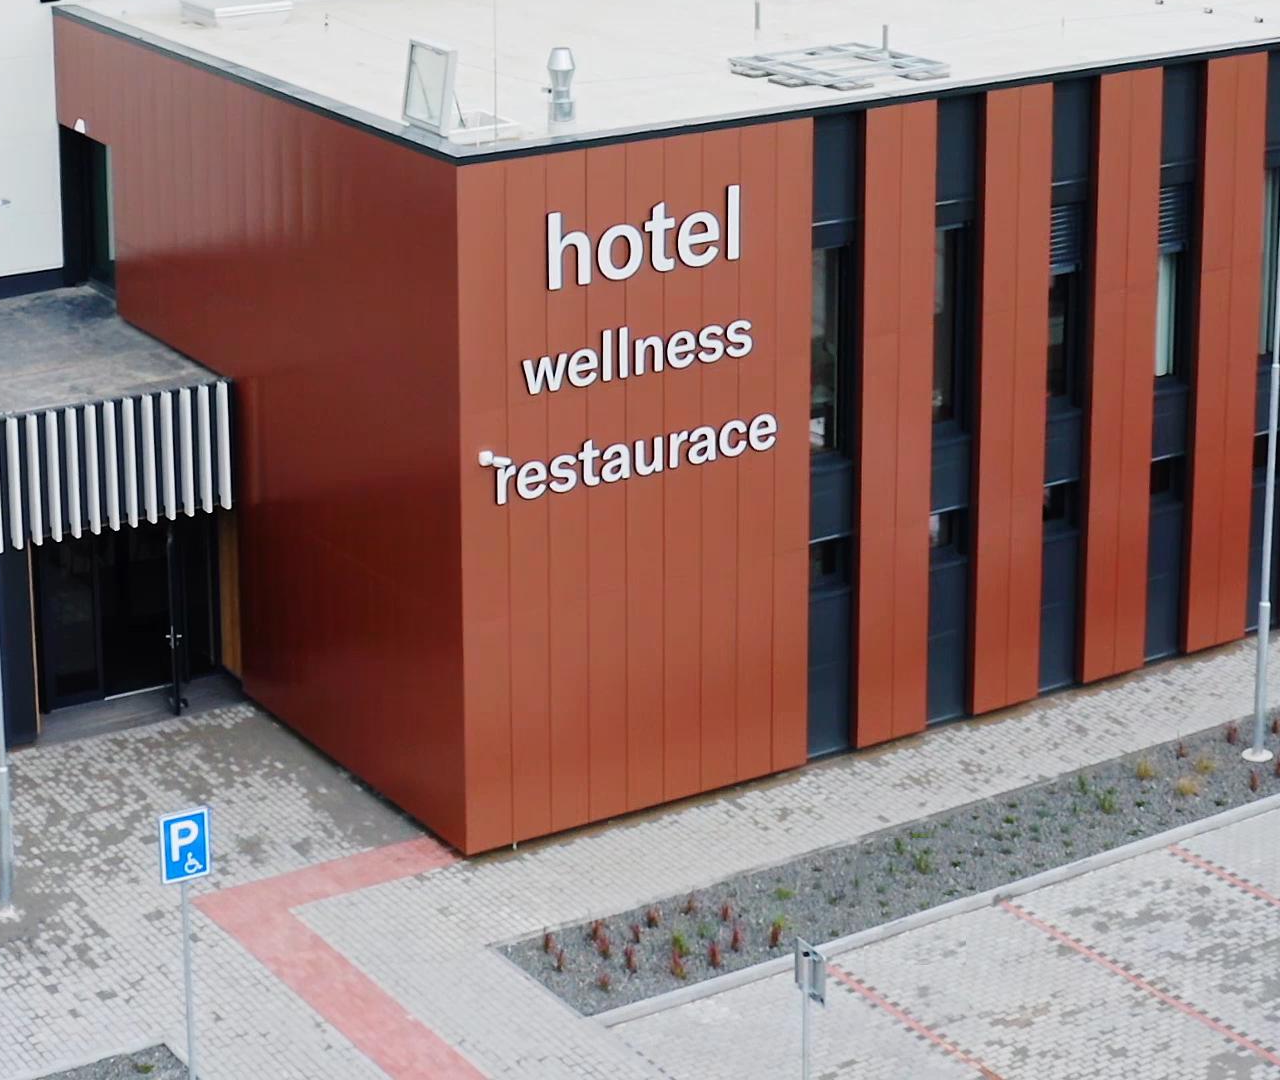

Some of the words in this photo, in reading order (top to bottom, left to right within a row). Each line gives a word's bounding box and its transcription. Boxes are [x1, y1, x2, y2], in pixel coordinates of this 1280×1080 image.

[547, 184, 741, 291] hotel
[522, 319, 753, 395] wellness
[494, 412, 778, 505] restaurace
[170, 820, 199, 863] P
